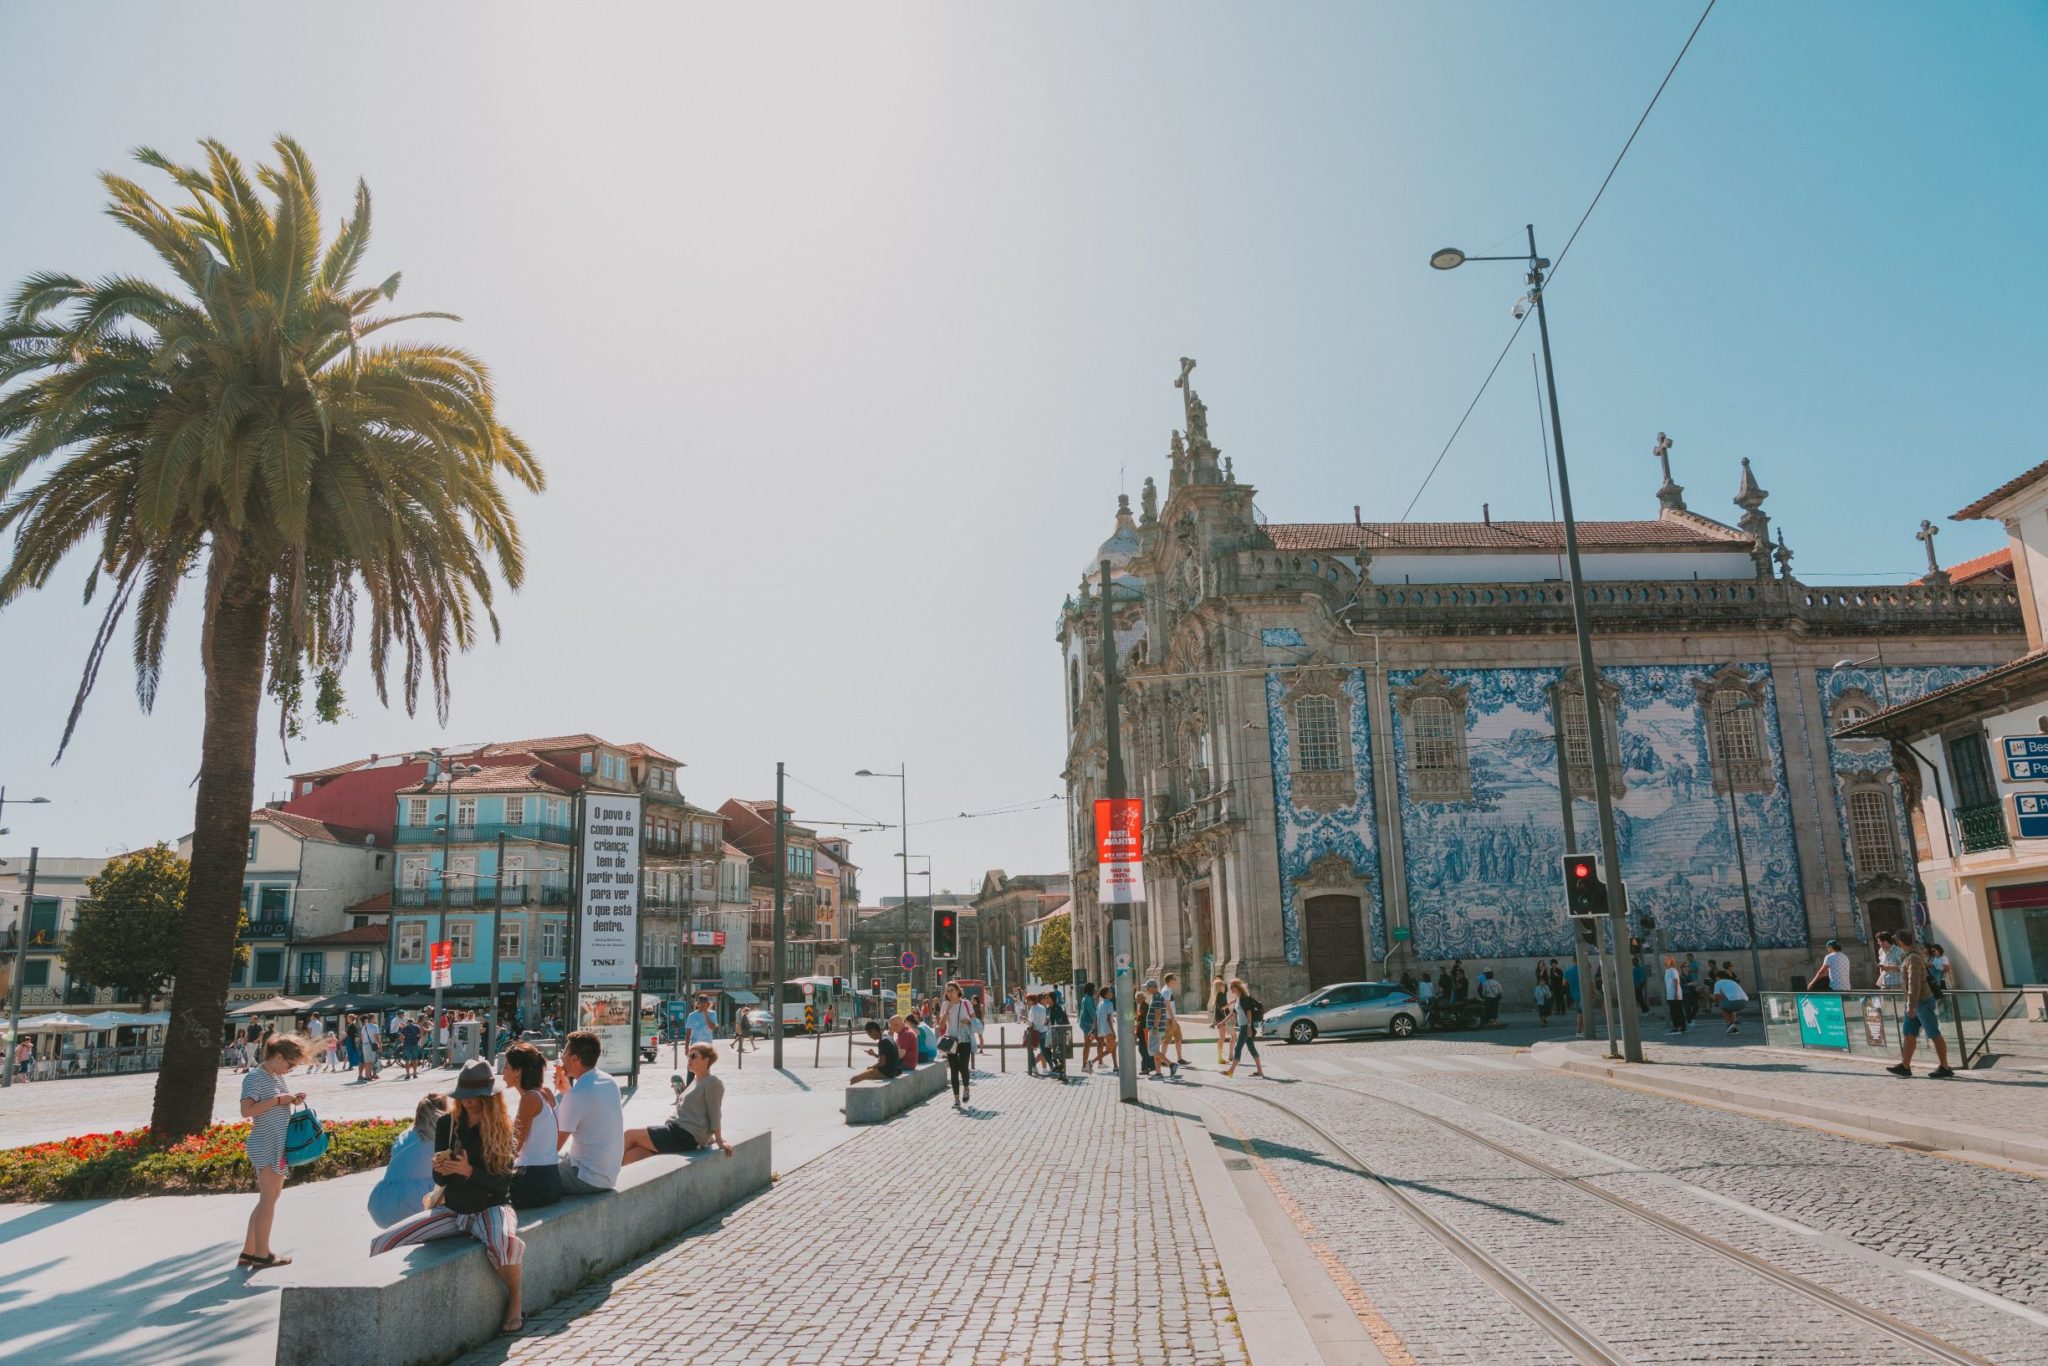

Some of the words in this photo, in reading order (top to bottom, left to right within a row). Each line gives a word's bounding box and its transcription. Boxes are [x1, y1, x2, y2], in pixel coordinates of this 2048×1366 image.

[2040, 798, 2048, 809] P
[595, 807, 600, 819] O
[603, 809, 623, 821] povo
[626, 808, 631, 820] é
[590, 825, 613, 835] como
[616, 826, 633, 836] uma
[594, 839, 629, 855] criança;
[597, 856, 612, 867] tem
[615, 856, 625, 867] de
[587, 872, 612, 885] partir
[616, 872, 633, 884] tudo
[591, 889, 611, 901] para
[614, 889, 629, 900] ver
[586, 906, 592, 916] o
[595, 905, 611, 917] que
[613, 903, 632, 916] está
[593, 920, 625, 932] dentro.
